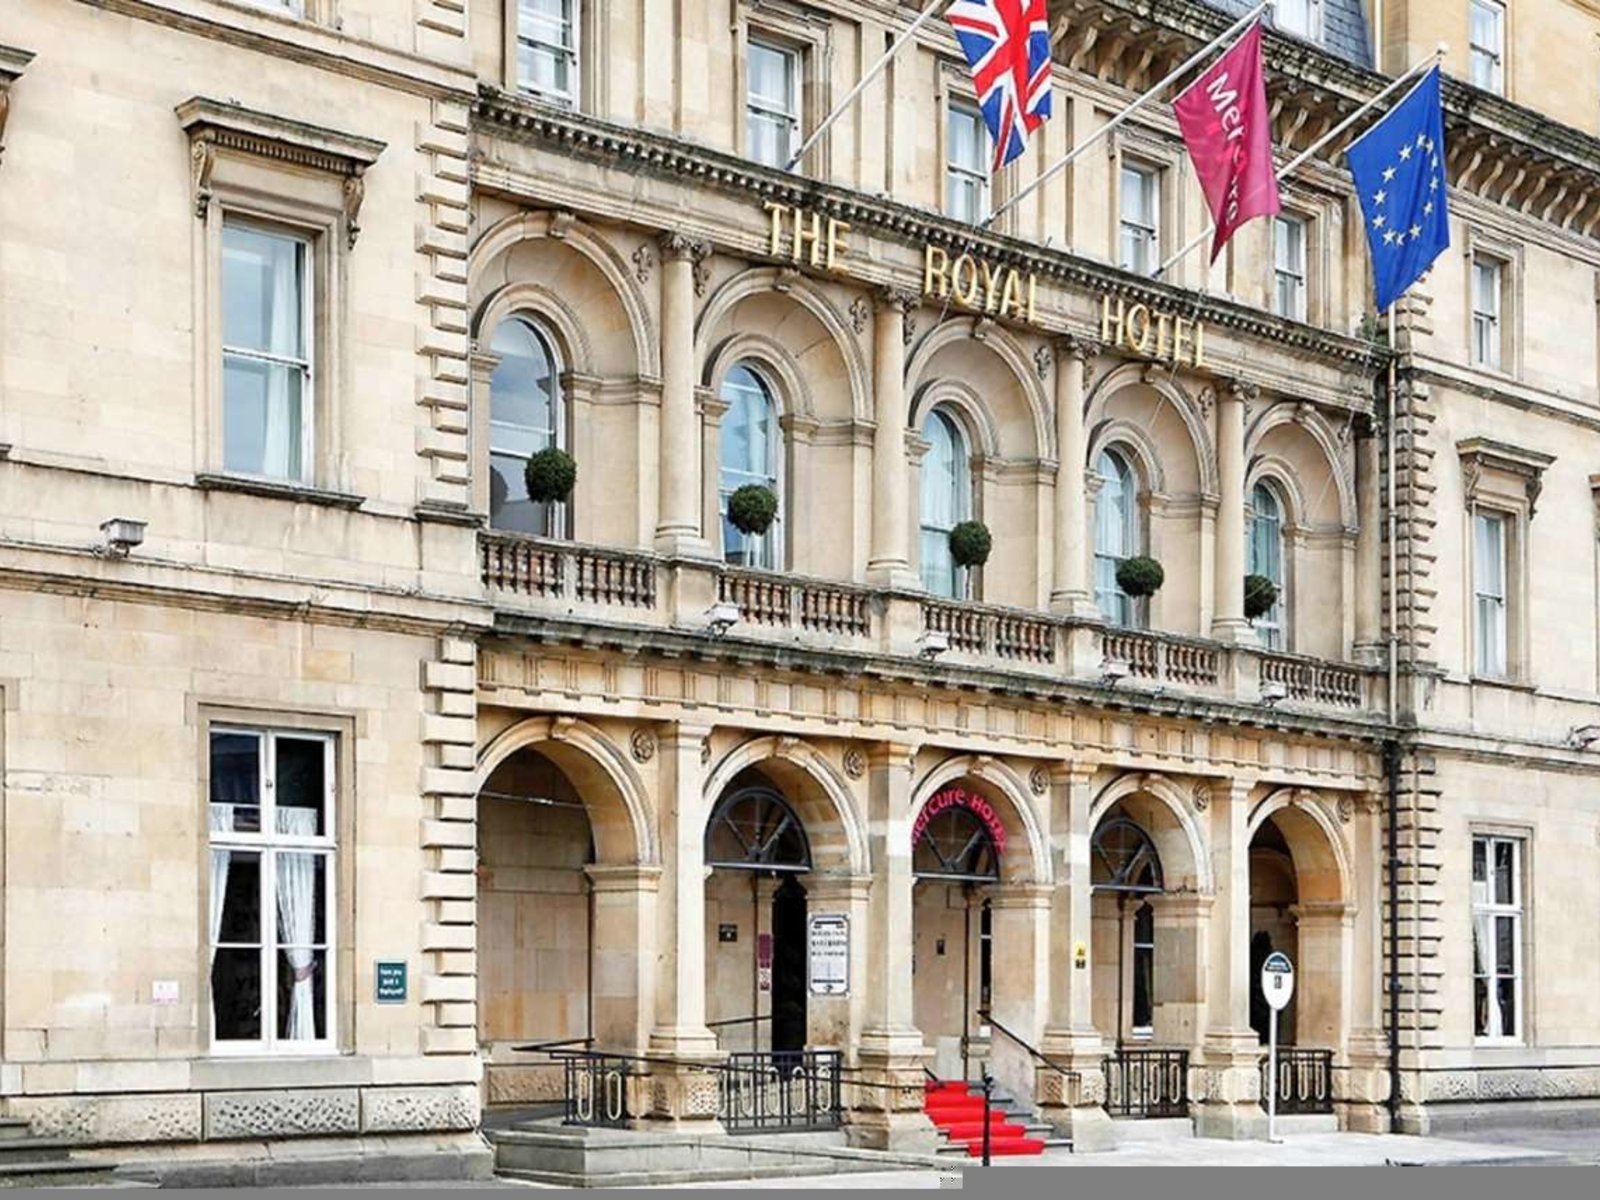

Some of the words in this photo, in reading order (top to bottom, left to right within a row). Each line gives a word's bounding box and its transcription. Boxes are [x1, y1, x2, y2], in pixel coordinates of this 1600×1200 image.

[1206, 72, 1247, 224] Merre
[764, 201, 850, 276] THE
[924, 244, 1041, 326] ROYAL
[1102, 295, 1207, 368] HOTEL
